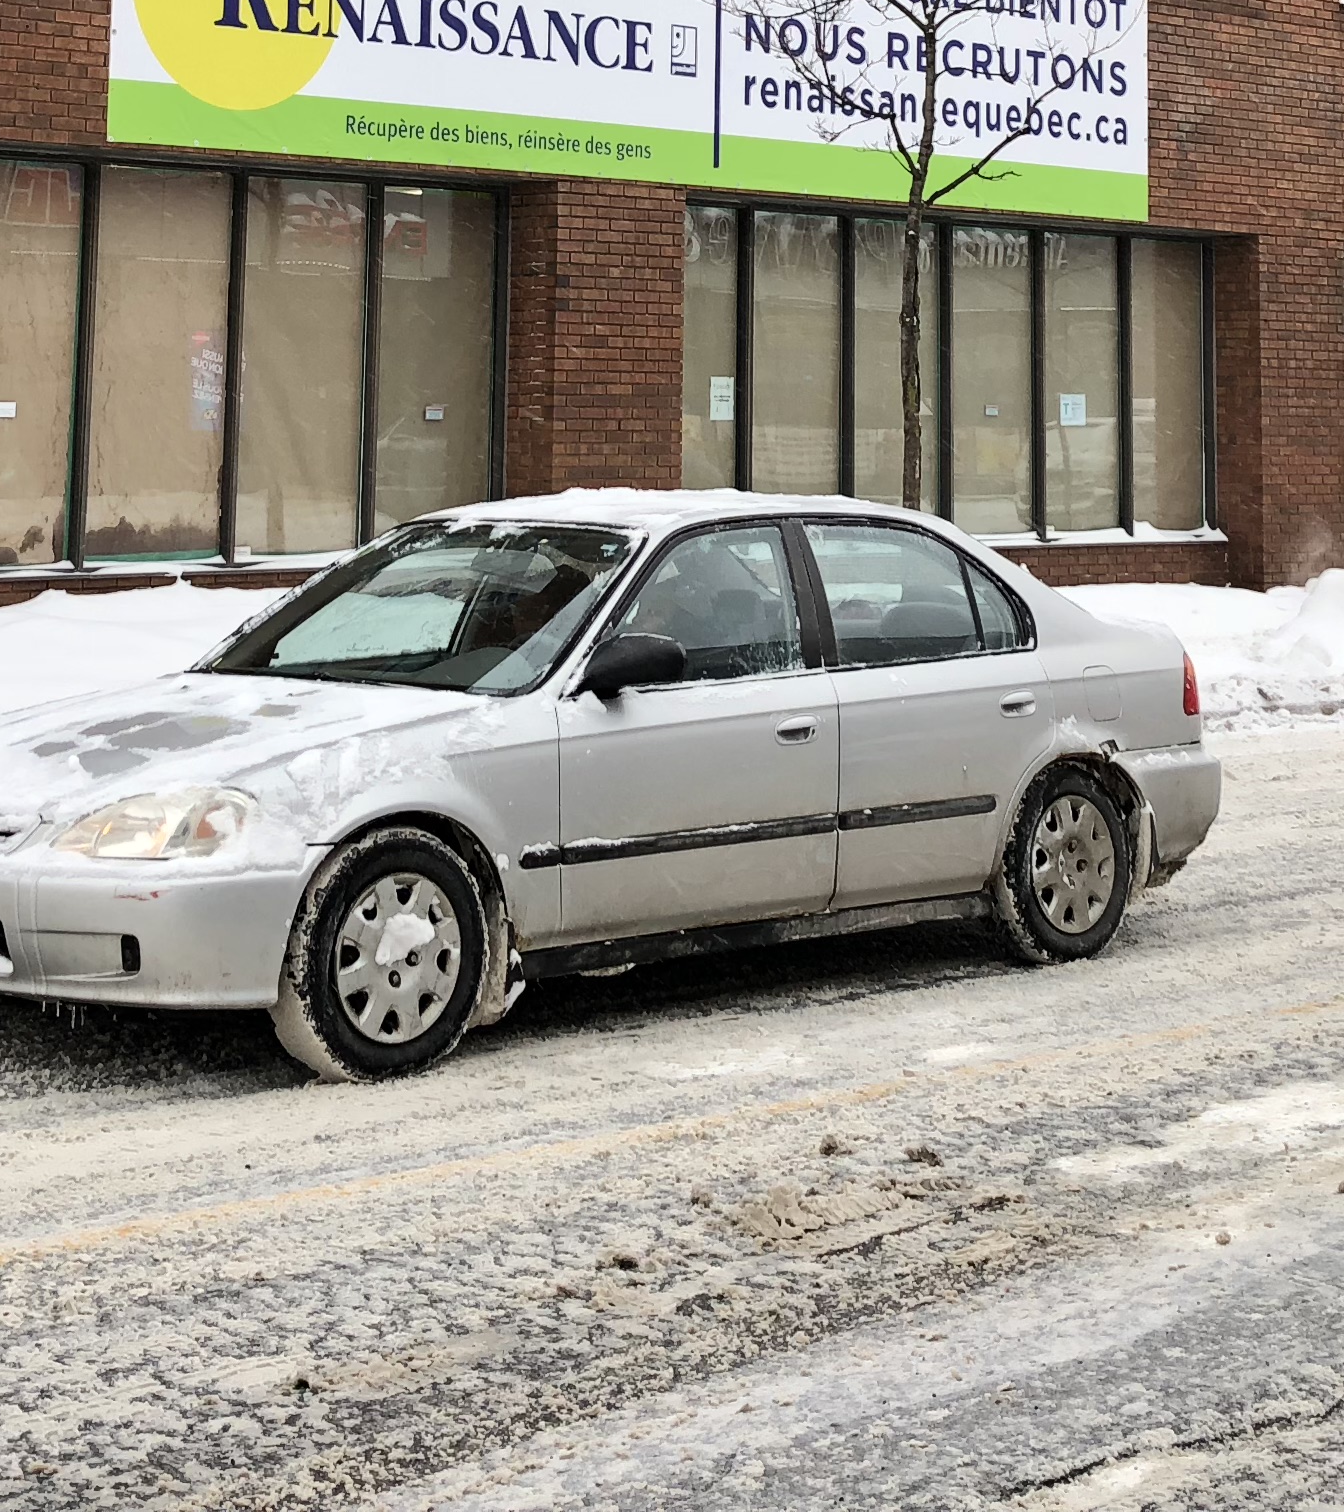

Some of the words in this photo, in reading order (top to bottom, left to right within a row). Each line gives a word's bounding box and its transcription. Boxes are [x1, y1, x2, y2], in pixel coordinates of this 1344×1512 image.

[745, 14, 867, 65] NOUS
[887, 31, 1128, 97] RECRUTONS
[346, 115, 425, 142] Récupère
[430, 122, 460, 143] des
[465, 125, 513, 149] biens,
[518, 129, 580, 153] réinsère
[585, 136, 611, 155] des
[616, 143, 652, 161] gens
[744, 74, 1129, 146] renaissanequebec.ca
